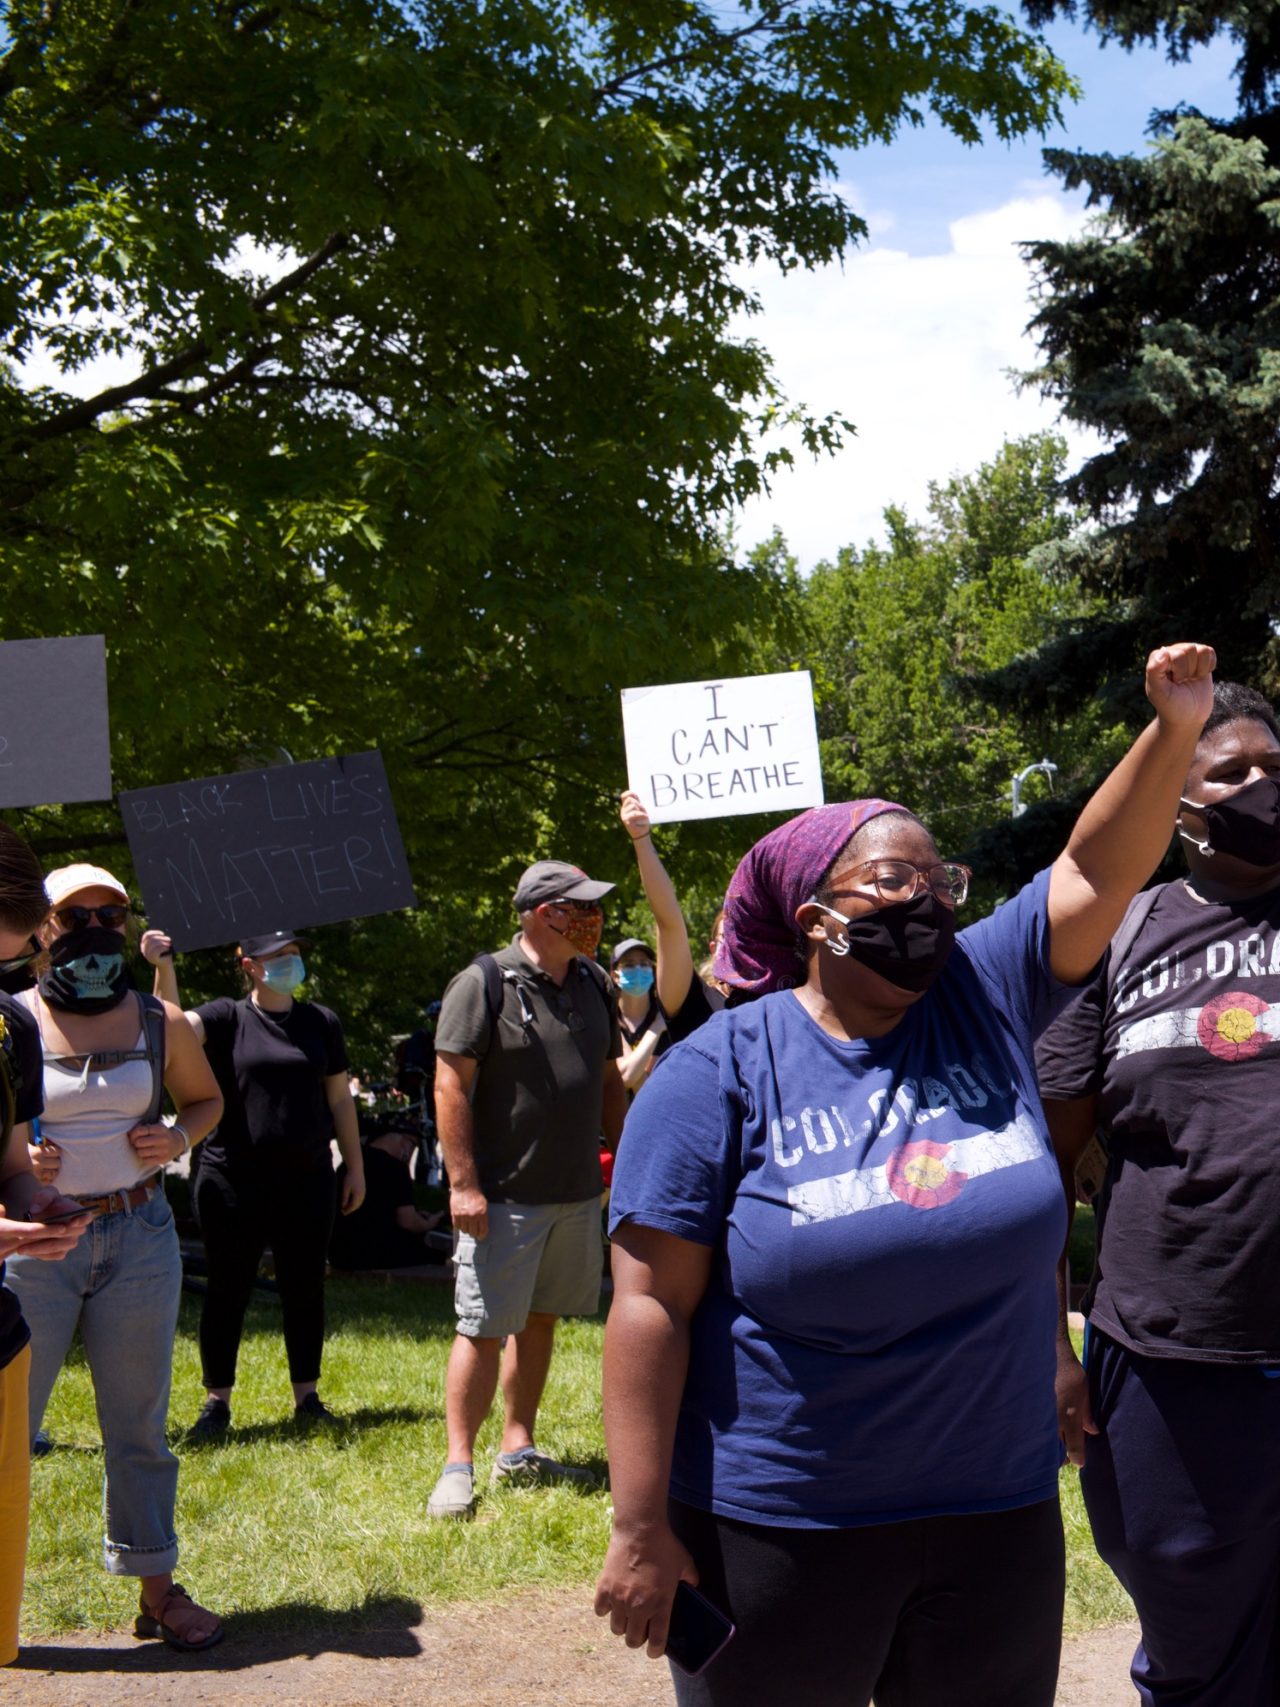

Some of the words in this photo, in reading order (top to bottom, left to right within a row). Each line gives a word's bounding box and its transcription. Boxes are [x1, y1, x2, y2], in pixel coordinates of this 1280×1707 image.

[703, 684, 728, 722] I
[671, 722, 779, 766] CAN'T
[131, 784, 243, 832] BLACK
[262, 774, 384, 821] LIVES
[650, 761, 804, 808] BREATHE
[166, 826, 400, 929] MATTER!
